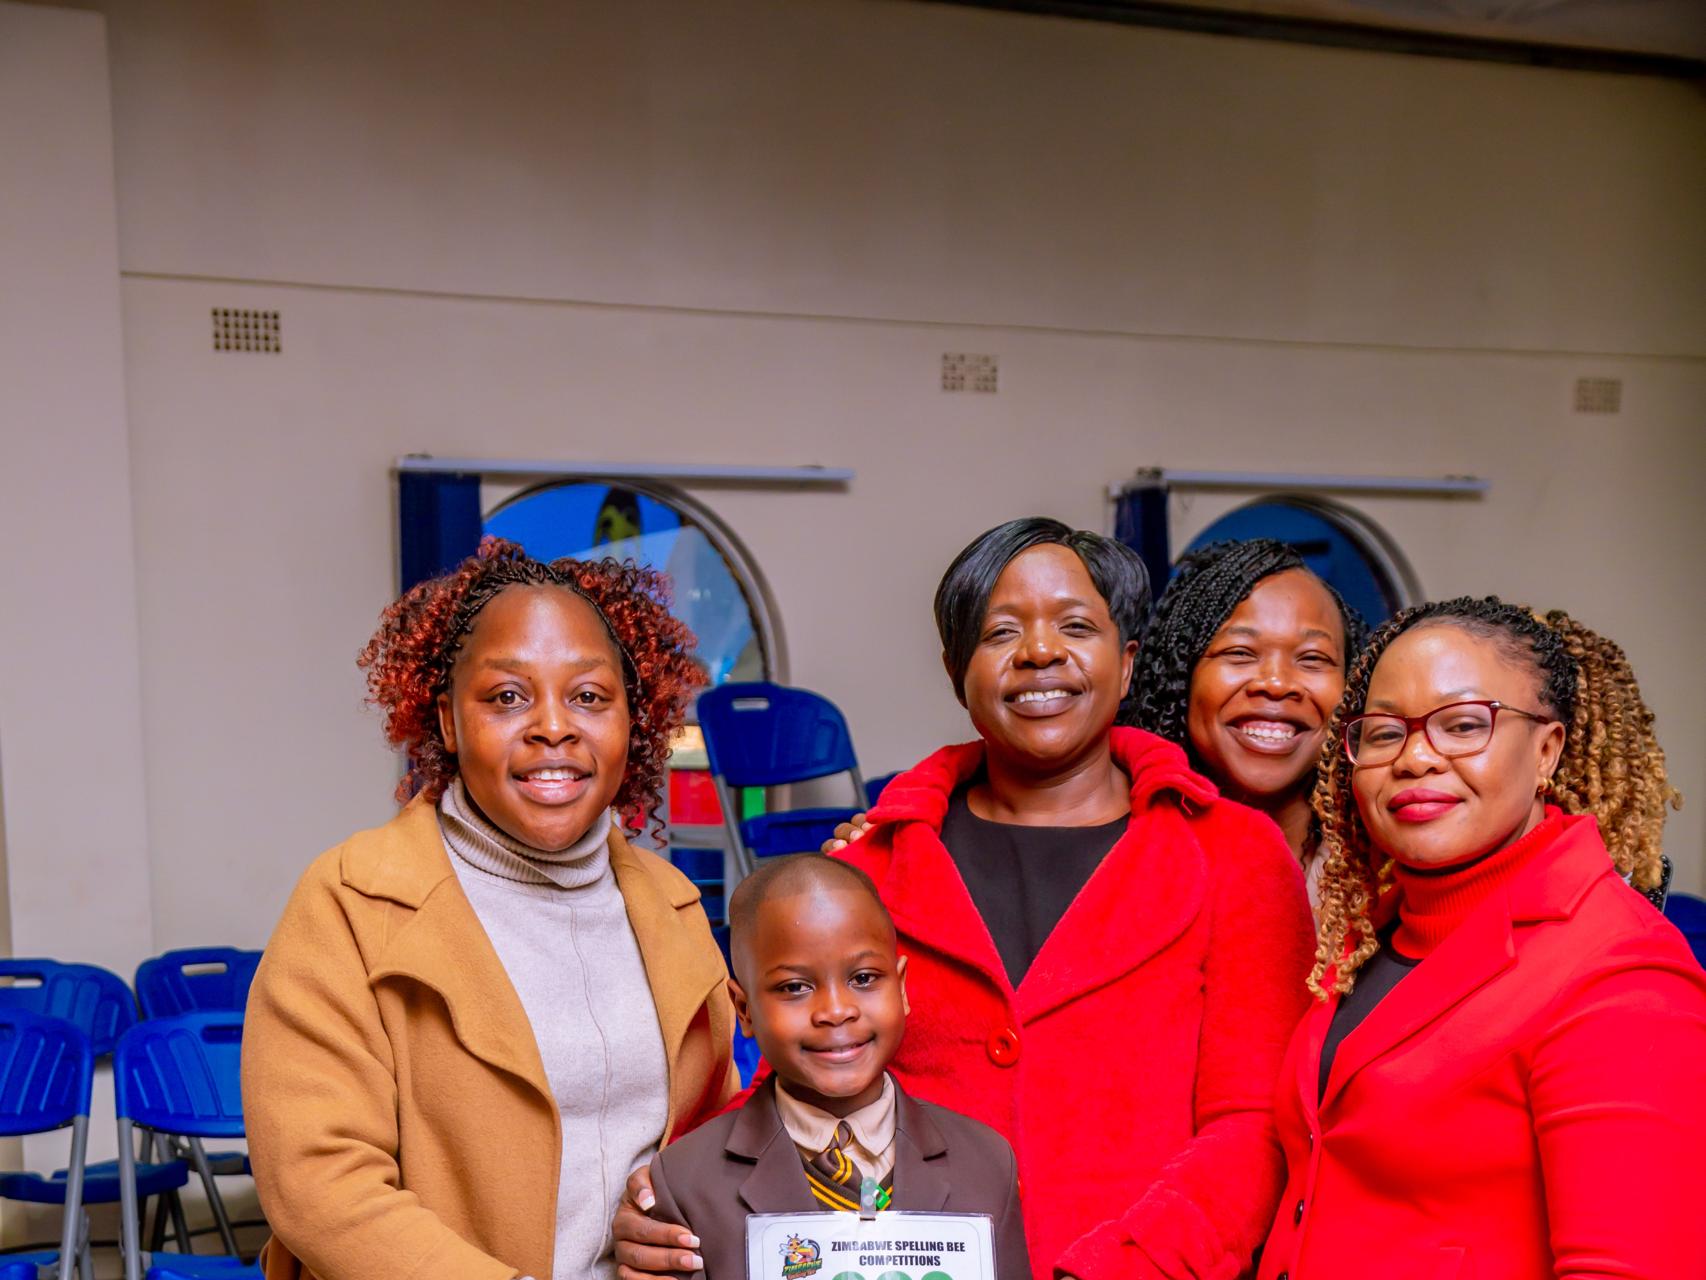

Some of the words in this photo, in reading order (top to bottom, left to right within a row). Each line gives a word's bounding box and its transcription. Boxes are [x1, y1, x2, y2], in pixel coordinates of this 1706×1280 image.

[831, 1241, 893, 1252] ZIMBABWE
[895, 1240, 944, 1252] SPELLING
[946, 1241, 966, 1252] BEE
[859, 1255, 941, 1266] COMPETITIONS
